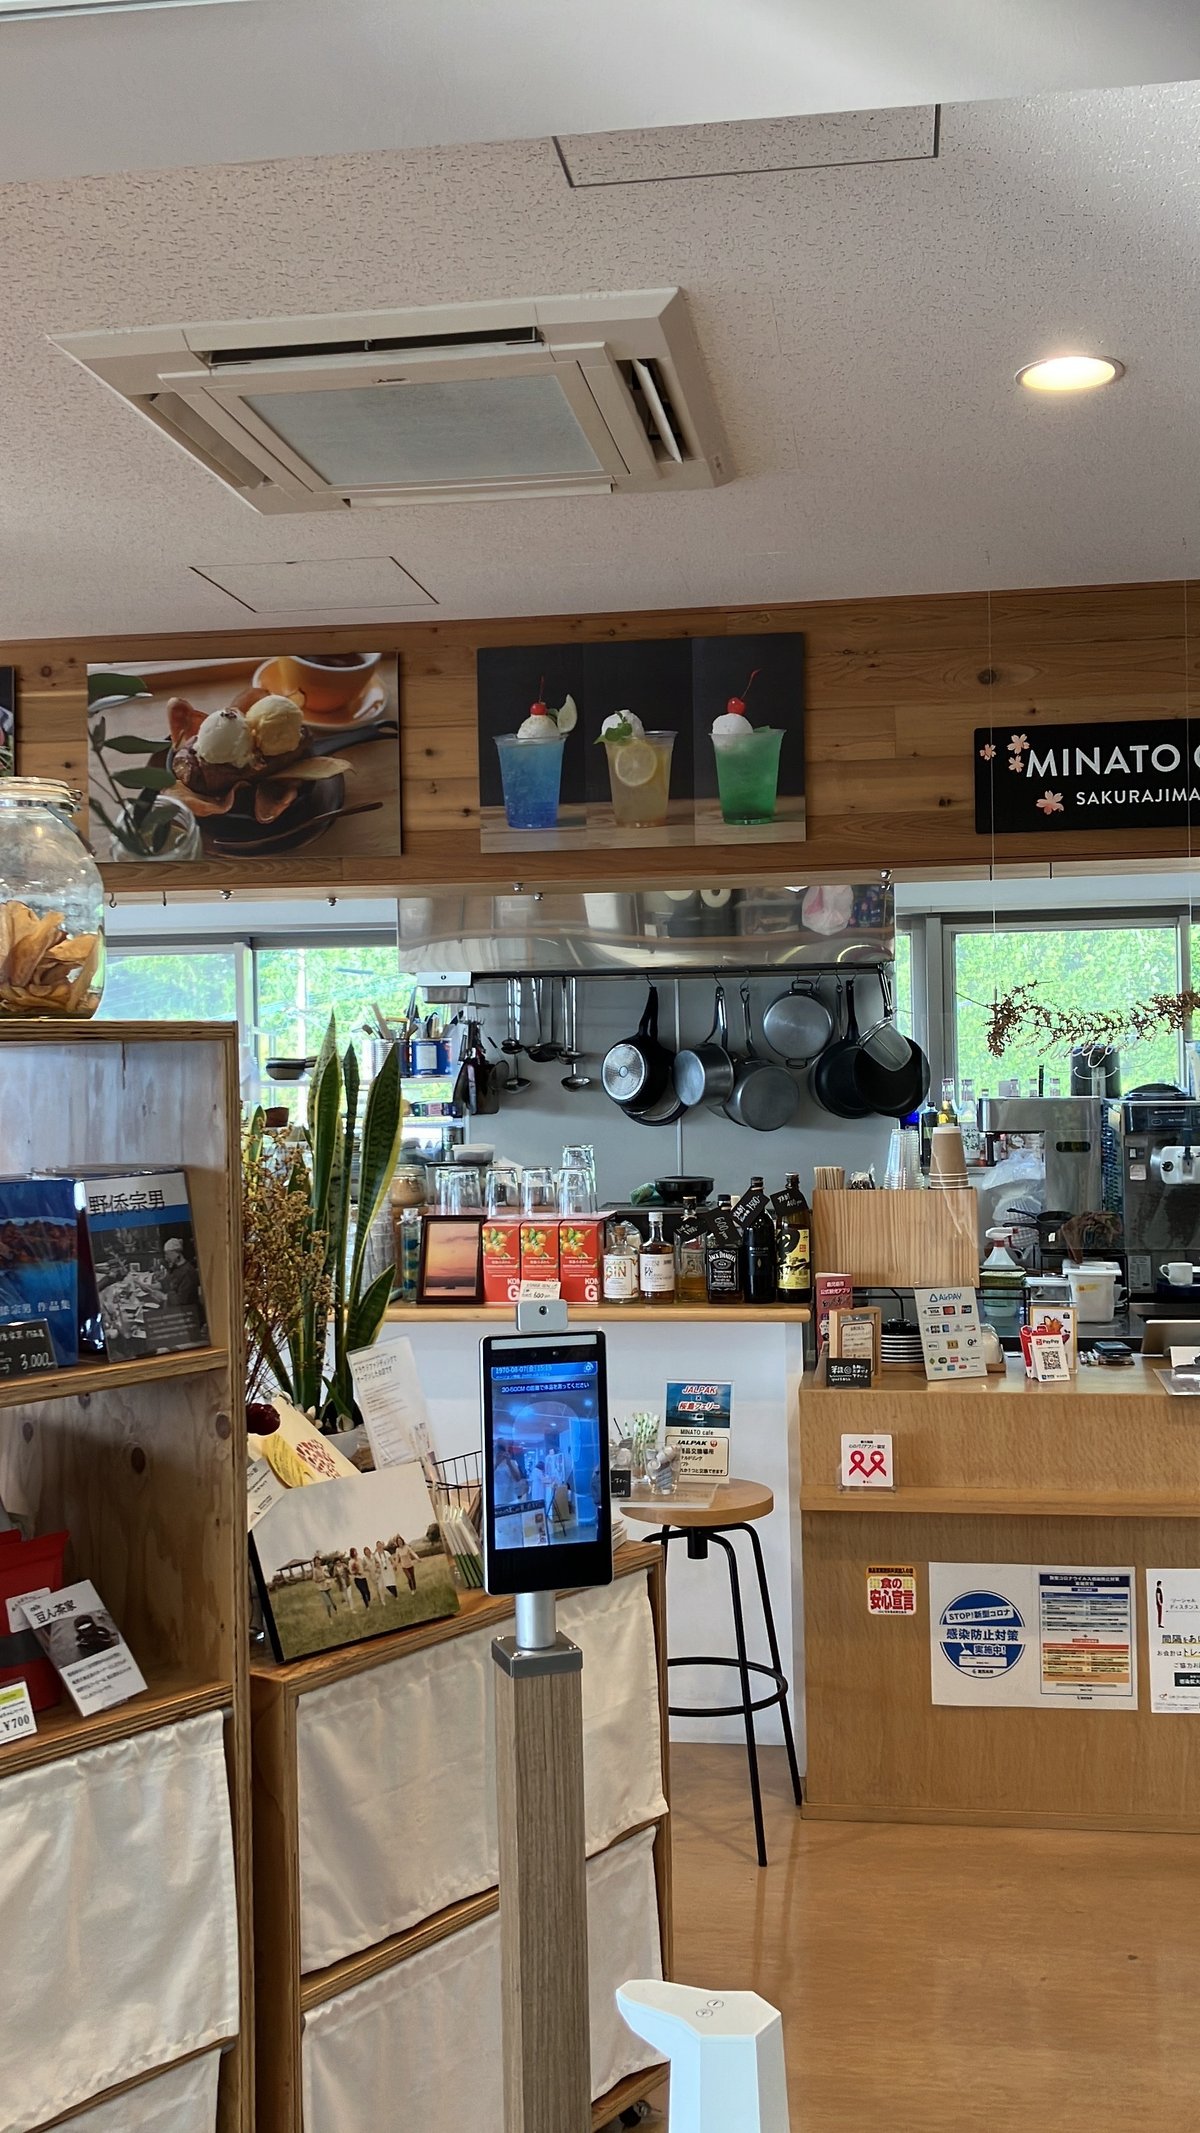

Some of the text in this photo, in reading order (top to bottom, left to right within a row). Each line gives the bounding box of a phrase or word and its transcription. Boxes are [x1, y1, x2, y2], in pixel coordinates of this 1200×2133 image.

[1026, 743, 1181, 778] MINATO
[1076, 787, 1200, 806] SAKURAJIMA
[682, 1385, 718, 1395] JALPAK
[678, 1401, 721, 1412] 桜島フェリー
[680, 1428, 701, 1436] MINATO
[880, 1577, 903, 1589] 食の
[870, 1589, 914, 1611] 安心宣言
[946, 1628, 1019, 1642] 感染防止対策
[3, 1713, 30, 1732] ¥700
